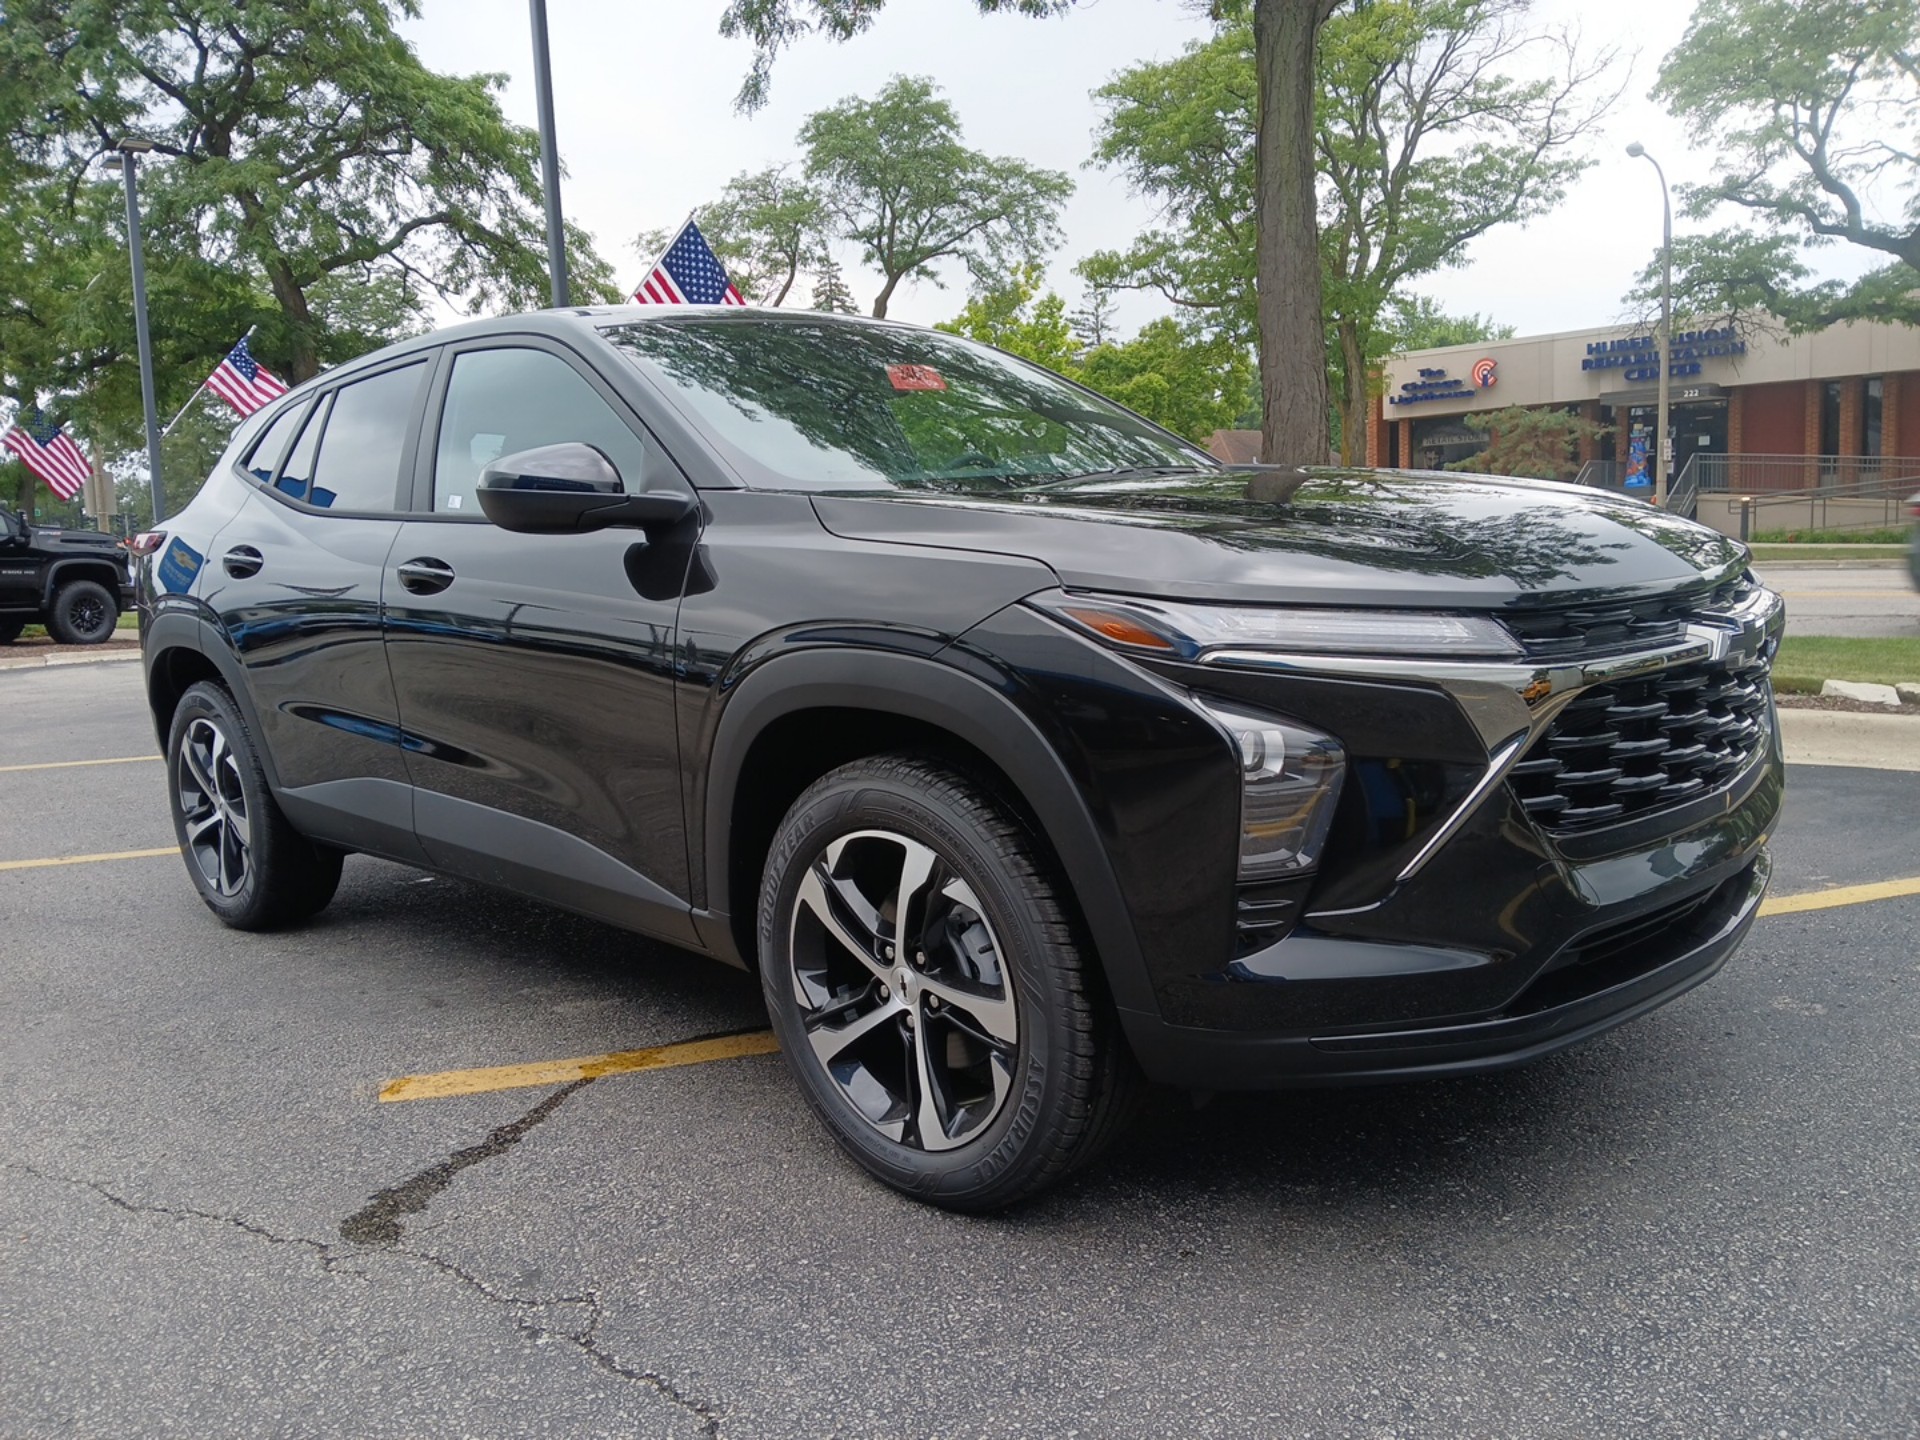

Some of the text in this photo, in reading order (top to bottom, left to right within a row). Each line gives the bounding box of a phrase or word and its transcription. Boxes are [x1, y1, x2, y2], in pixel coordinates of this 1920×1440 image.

[1581, 340, 1746, 371] REHABILTATION
[1683, 389, 1699, 398] 222
[973, 1052, 1045, 1183] ASSURANCE
